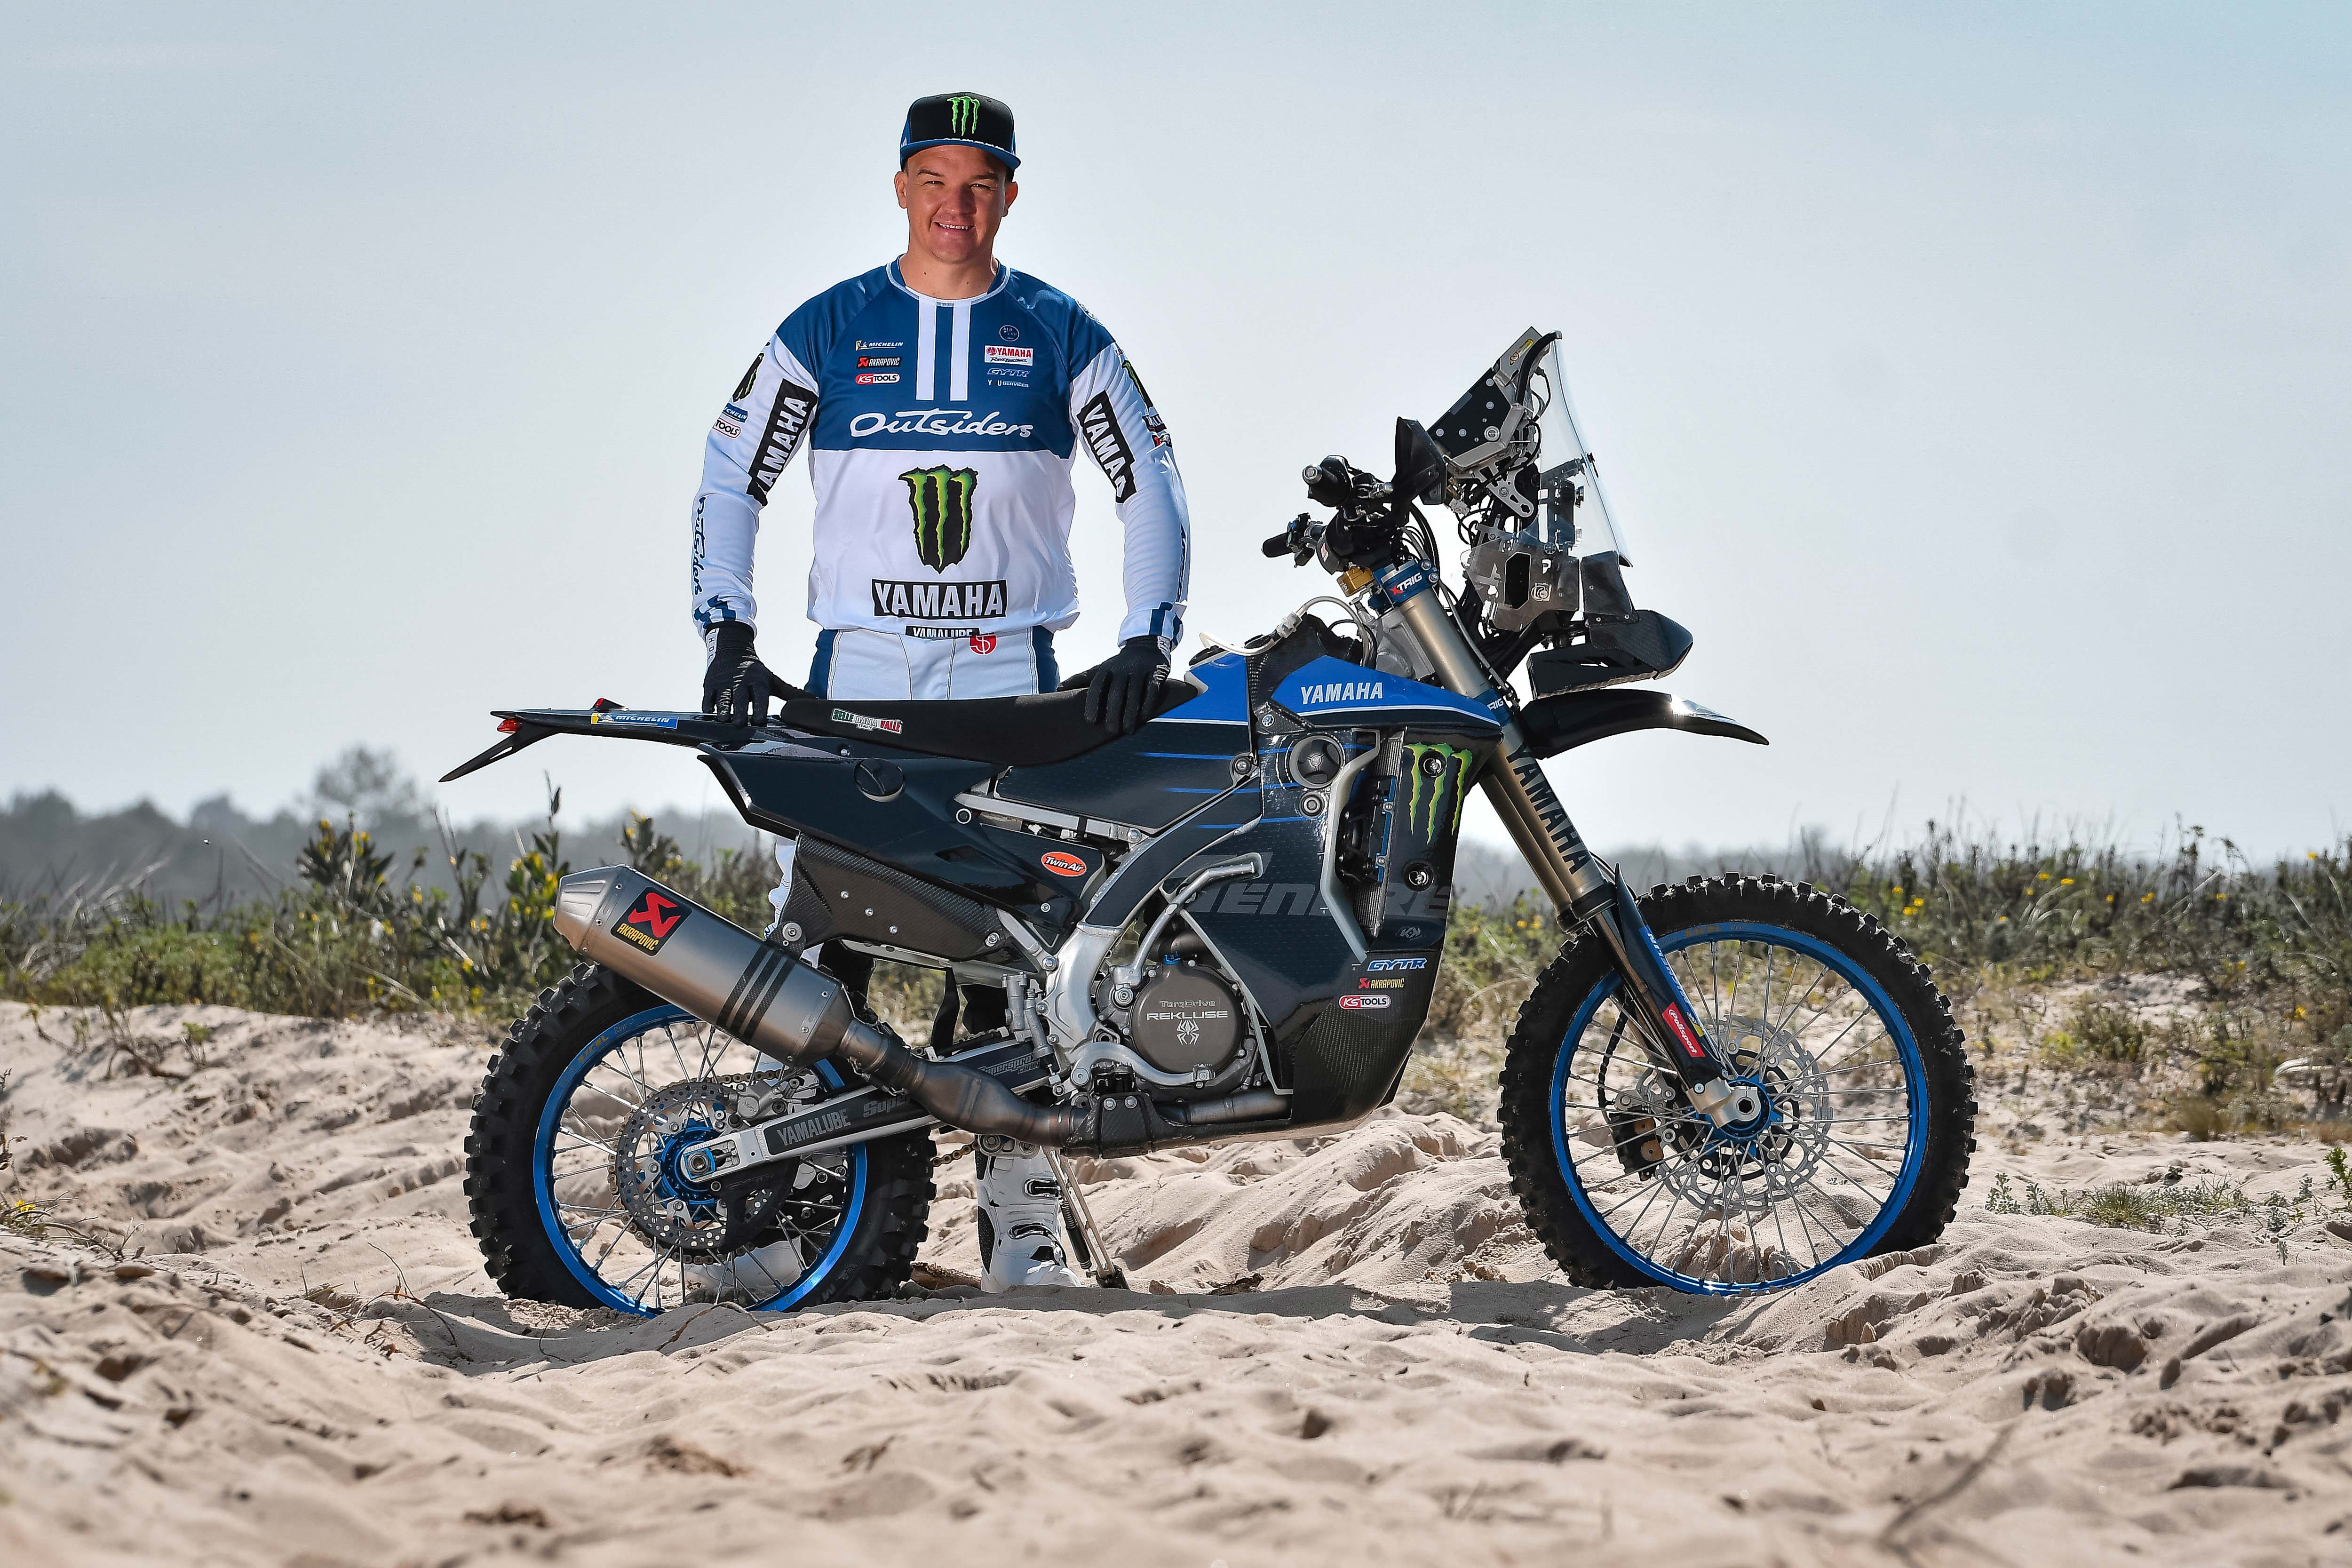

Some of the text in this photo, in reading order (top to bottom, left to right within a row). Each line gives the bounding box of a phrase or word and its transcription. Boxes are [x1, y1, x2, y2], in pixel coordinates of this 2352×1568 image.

[997, 347, 1032, 358] YAMAHA
[987, 368, 1029, 377] GYTR
[850, 408, 1034, 438] Outsiders
[874, 582, 1003, 617] YAMAHA
[1301, 682, 1383, 704] YAMAHA
[833, 709, 901, 732] SELLE DALLA VALLE
[1505, 741, 1592, 876] YAMAHA
[1045, 856, 1084, 872] Twin Air
[1367, 958, 1428, 971] GYTR
[1147, 1011, 1228, 1020] REKLUSE
[1669, 1009, 1697, 1053] Polisport
[777, 1109, 851, 1146] YAMALUBE
